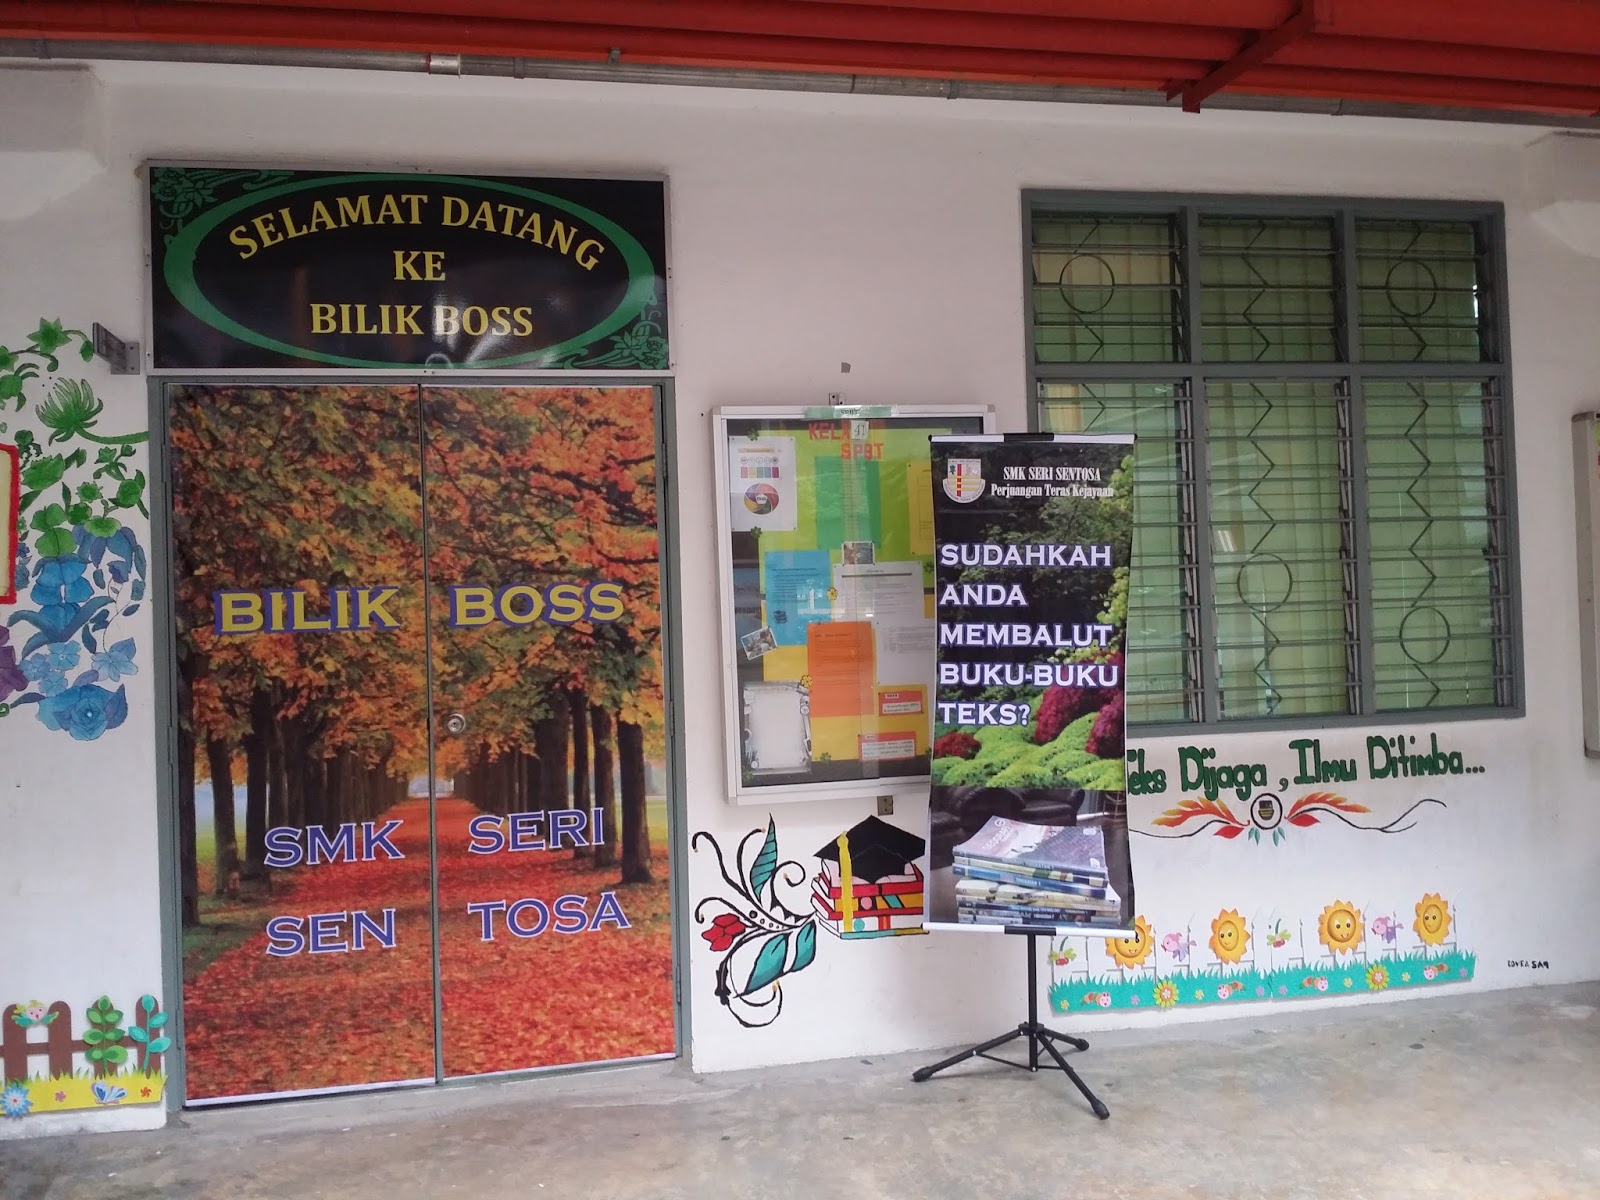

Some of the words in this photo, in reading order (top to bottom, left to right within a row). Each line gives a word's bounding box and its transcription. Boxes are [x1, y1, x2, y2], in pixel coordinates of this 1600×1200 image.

[229, 194, 428, 260] SELAMAT
[441, 196, 605, 271] DATANG
[393, 250, 446, 281] KE
[310, 303, 423, 335] BILIK
[433, 305, 533, 337] BOSS
[1003, 466, 1026, 480] SMK
[1028, 466, 1054, 481] SERI
[1055, 467, 1102, 481] SENTOSA
[991, 483, 1042, 498] Perjuangan
[1044, 484, 1071, 497] Teras
[1072, 483, 1114, 499] Kejayaan
[940, 544, 1112, 567] SUDAHKAH
[939, 584, 1028, 606] ANDA
[214, 586, 399, 634] BILIK
[449, 583, 624, 628] BOSS
[939, 623, 1113, 648] MEMBALUT
[939, 663, 1119, 687] BUKU-BUKU
[938, 702, 1031, 726] TEKS?
[264, 819, 406, 868] SMK
[467, 807, 606, 855] SERI
[265, 908, 396, 957] SEN
[467, 891, 632, 942] TOSA
